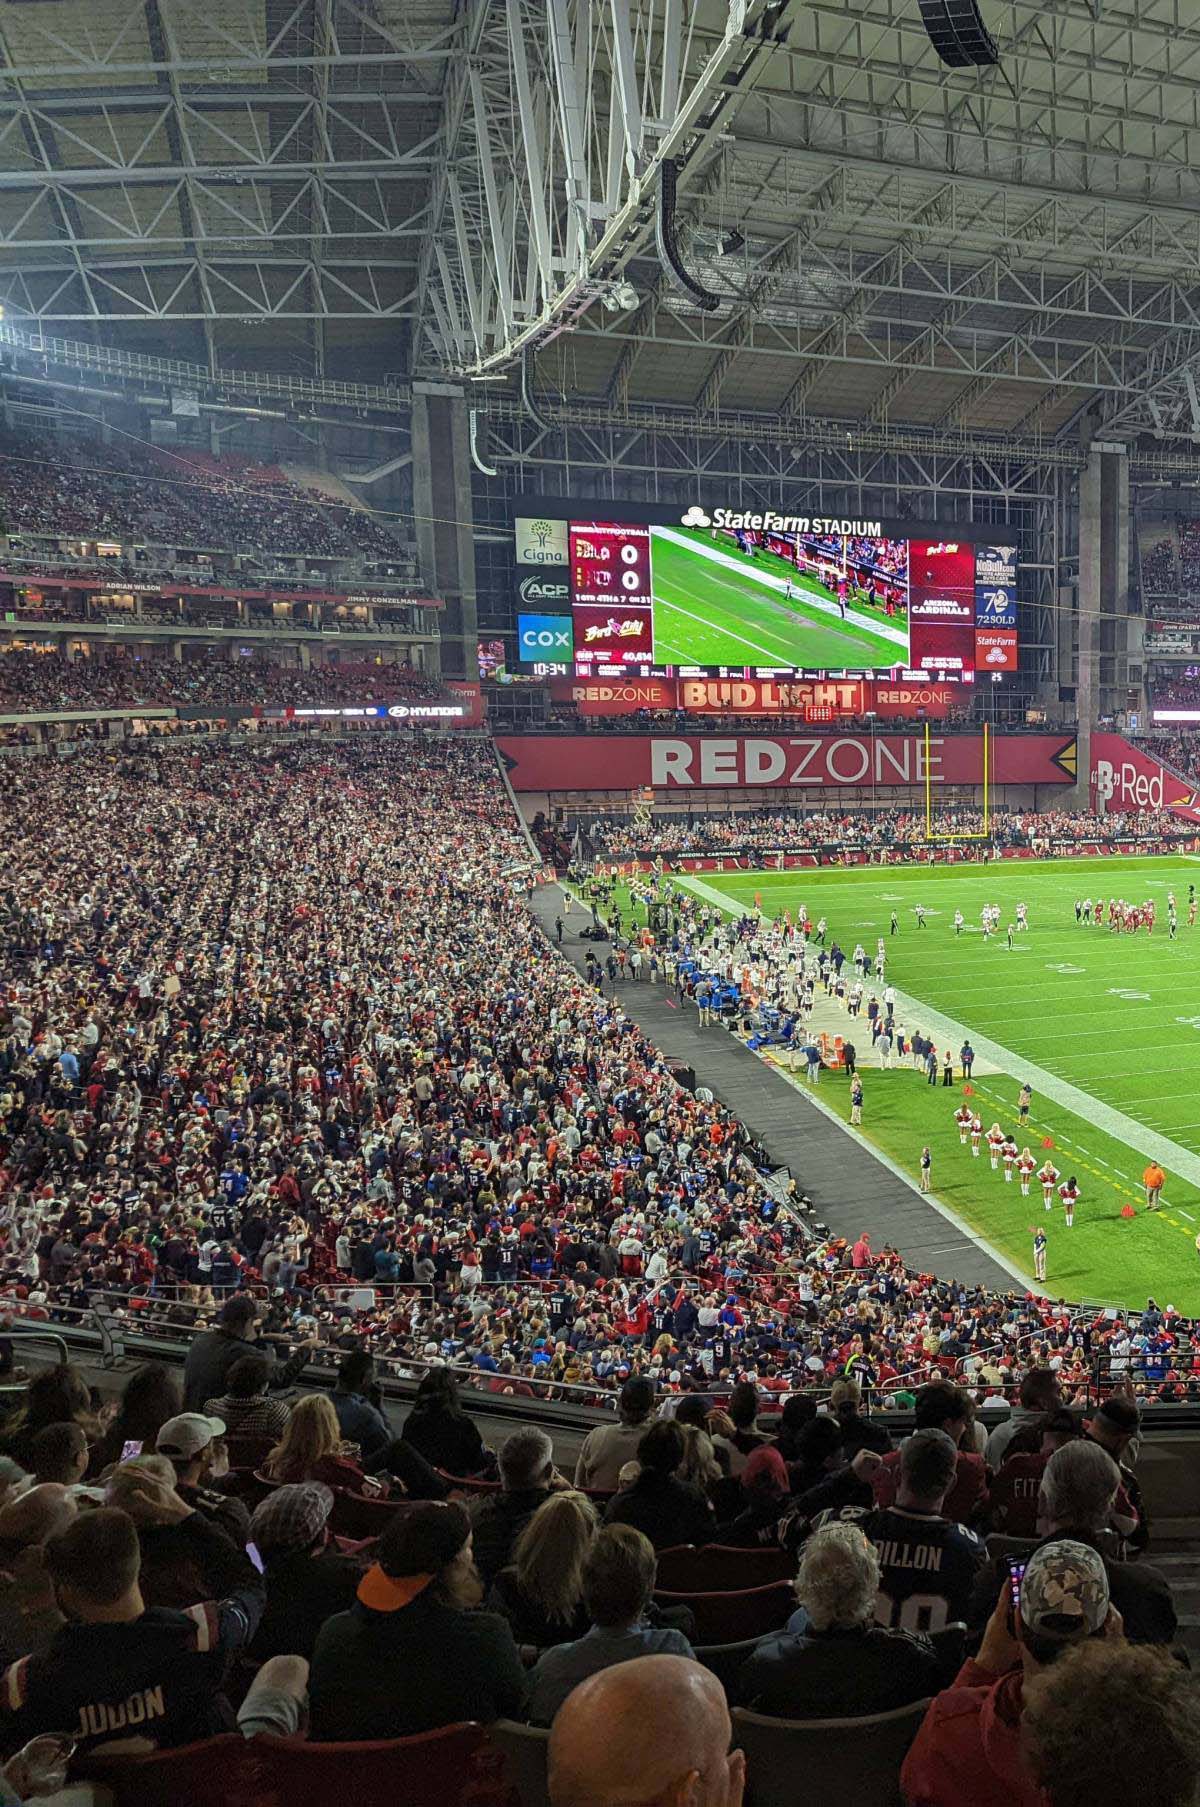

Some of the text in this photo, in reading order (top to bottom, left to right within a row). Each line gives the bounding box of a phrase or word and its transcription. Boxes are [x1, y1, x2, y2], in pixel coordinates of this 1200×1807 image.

[812, 518, 882, 538] STADIUM
[523, 547, 562, 563] Cigna
[621, 544, 638, 565] 0
[106, 582, 133, 590] ADRIAN
[622, 570, 640, 590] 0
[527, 584, 569, 596] ACP
[371, 597, 417, 605] CONZELMAN
[912, 606, 970, 615] CARDINALS
[523, 631, 570, 646] COX
[533, 663, 567, 676] 10:34
[572, 687, 662, 702] REDZONE
[684, 682, 857, 710] BUD LIGHT
[877, 690, 952, 704] REDZONE
[410, 706, 463, 717] HYUNDAI
[650, 739, 945, 785] REDZONE
[502, 1251, 512, 1263] 11
[552, 1302, 562, 1314] 11
[715, 1345, 724, 1357] 9
[73, 1683, 166, 1738] JUDON
